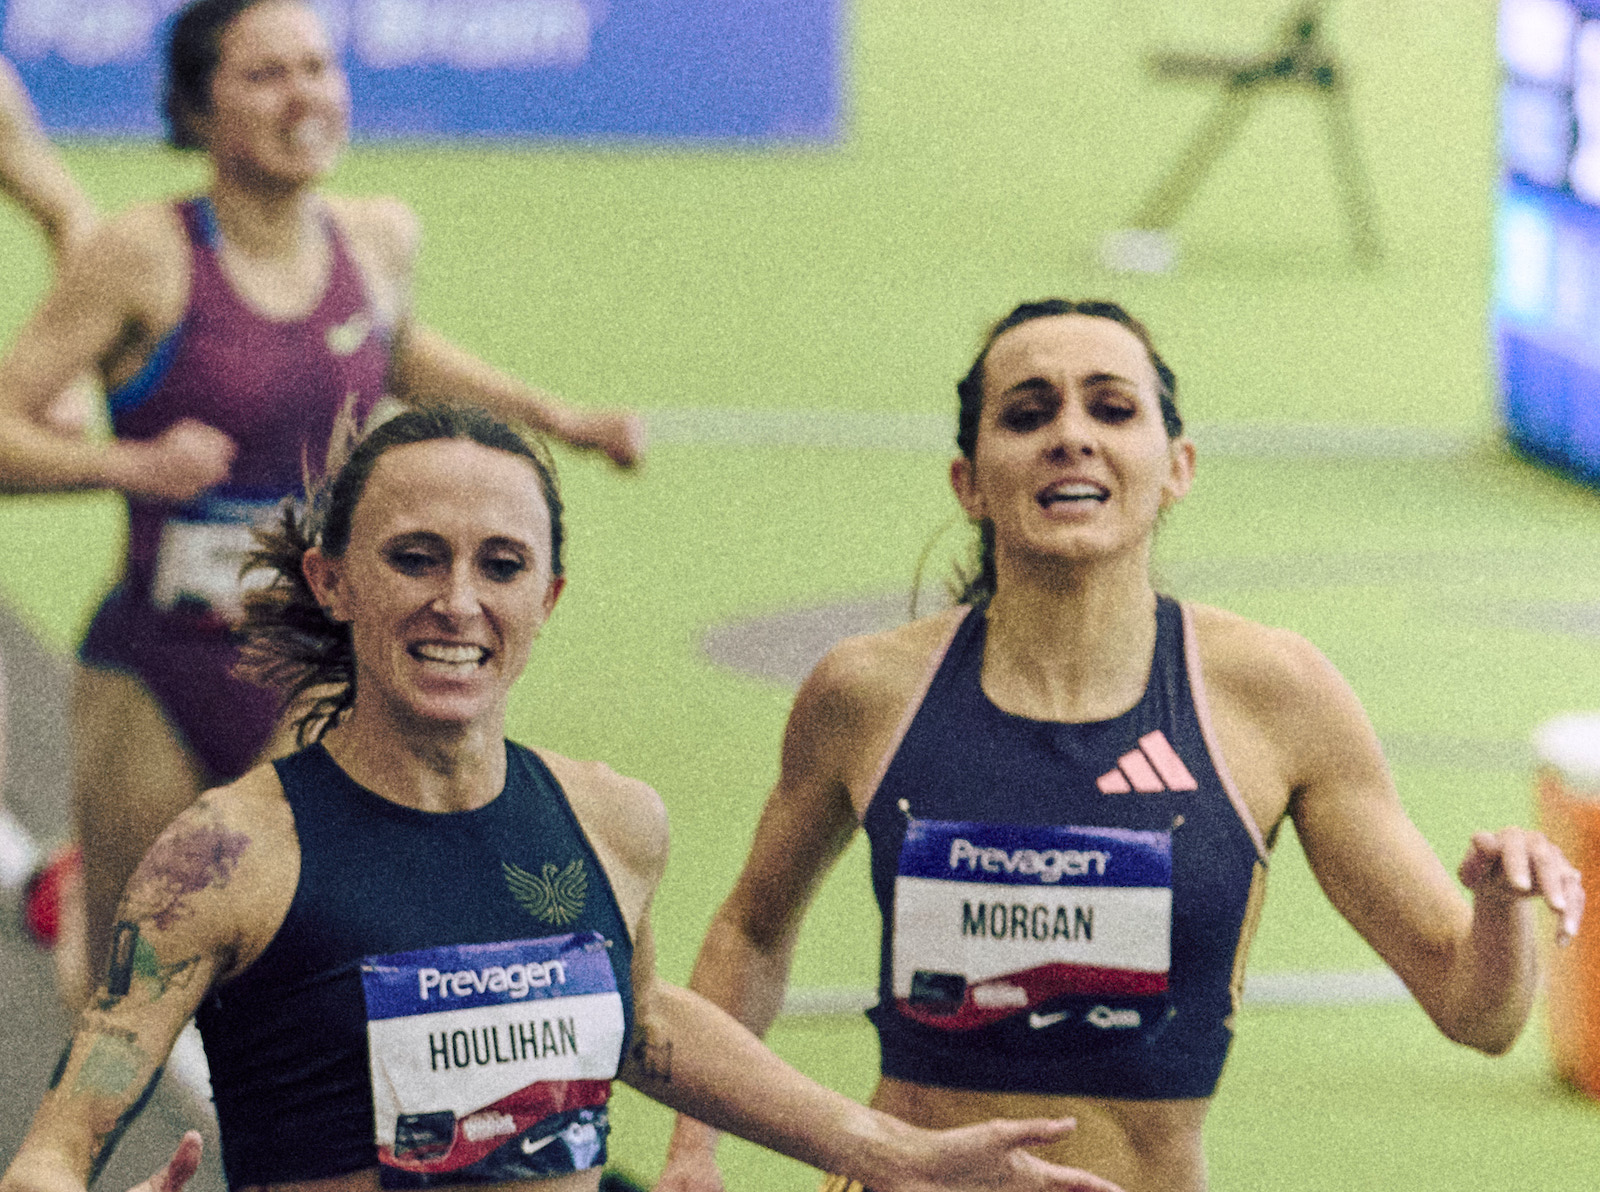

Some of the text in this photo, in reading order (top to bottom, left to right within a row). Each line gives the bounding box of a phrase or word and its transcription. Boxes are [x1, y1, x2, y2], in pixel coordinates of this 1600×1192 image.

[950, 838, 1108, 883] Prevagen
[963, 902, 1093, 941] MORGAN
[418, 959, 566, 1000] Prevagen
[429, 1017, 578, 1072] HOULIHAN
